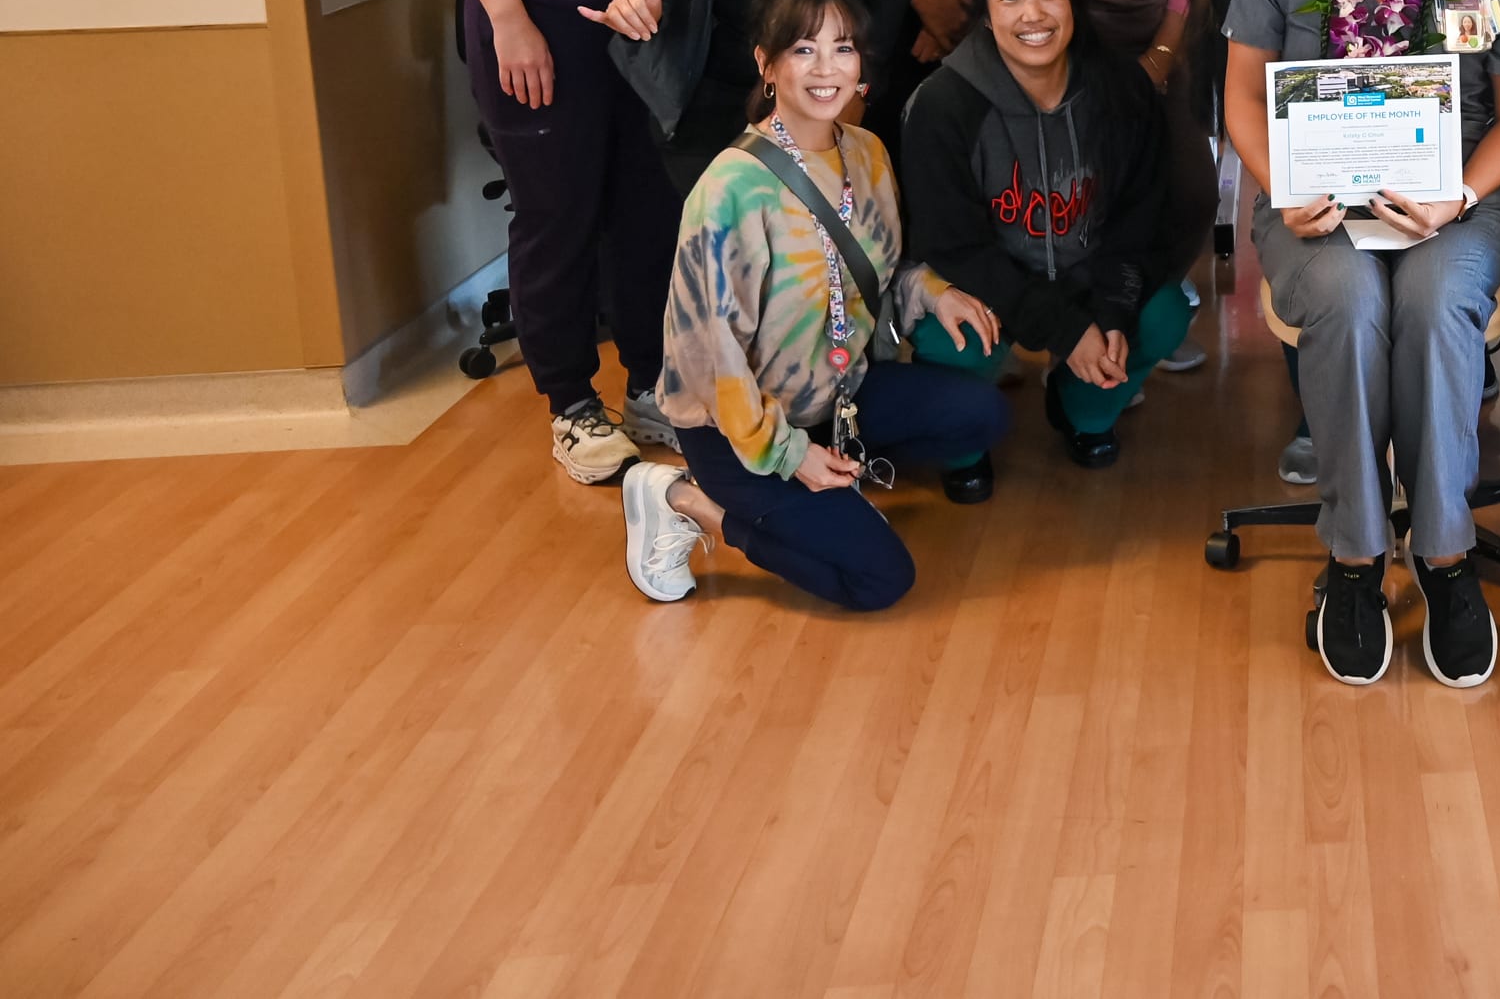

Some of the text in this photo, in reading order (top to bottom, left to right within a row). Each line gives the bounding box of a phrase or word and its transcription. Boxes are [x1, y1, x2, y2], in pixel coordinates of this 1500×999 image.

[1307, 110, 1421, 122] EMPLOYEE OF THE MONTH
